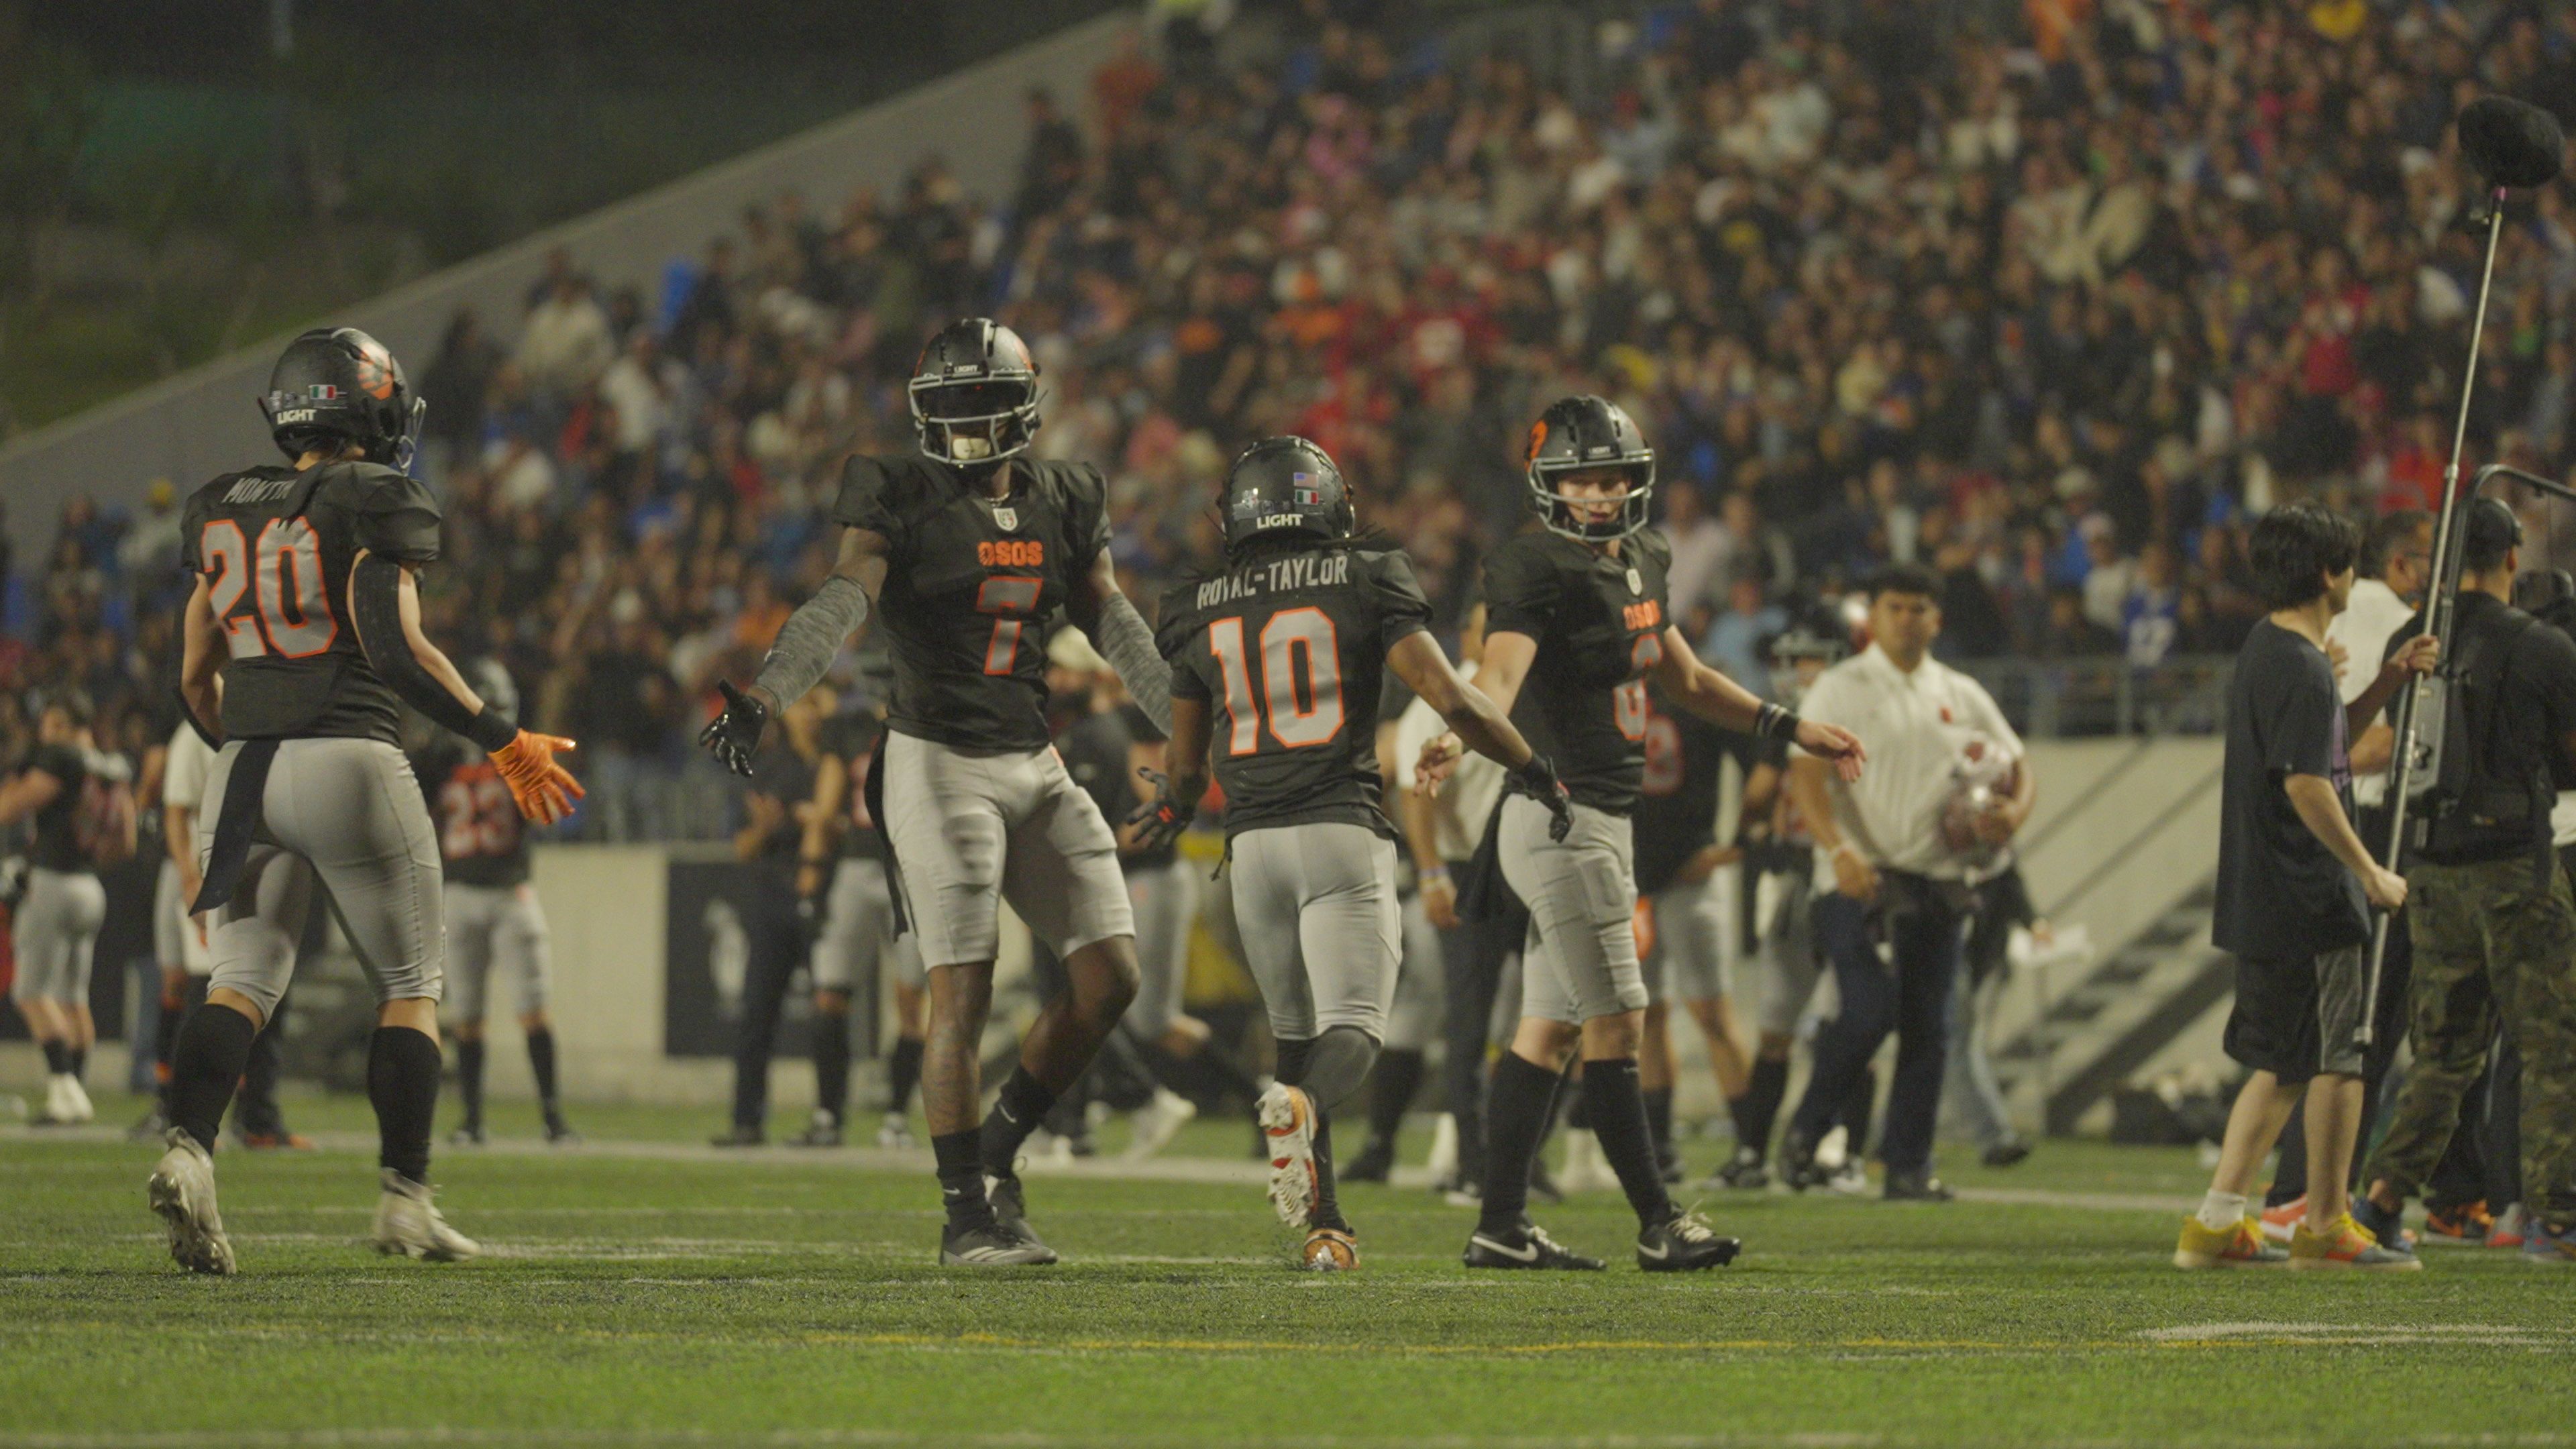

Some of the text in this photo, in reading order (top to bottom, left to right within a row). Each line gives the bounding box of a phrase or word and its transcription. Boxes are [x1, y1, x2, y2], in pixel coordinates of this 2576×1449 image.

[277, 409, 317, 425] LIGHT
[1256, 513, 1303, 529] LIGHT
[977, 541, 1043, 566] OSOS
[201, 515, 339, 659] 20
[1197, 555, 1348, 610] ROYAL-TAYLOR
[977, 576, 1044, 676] 7
[1209, 606, 1345, 756] 10
